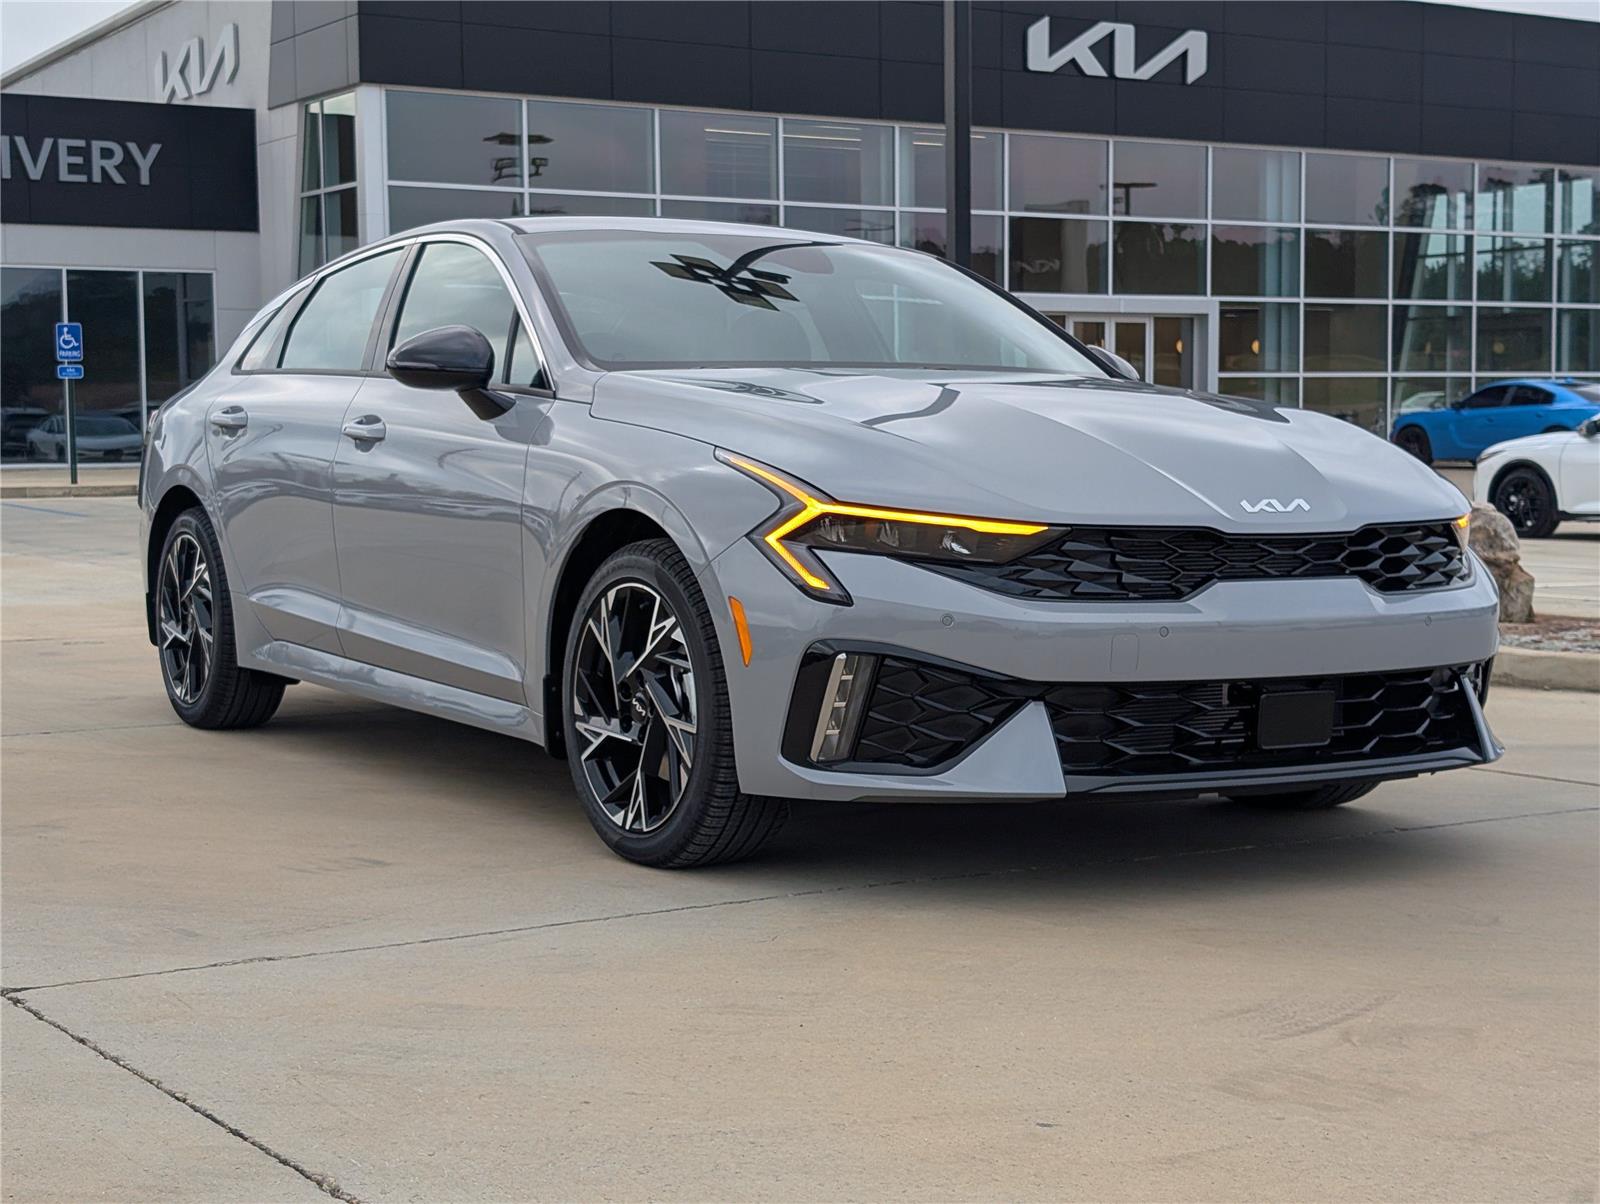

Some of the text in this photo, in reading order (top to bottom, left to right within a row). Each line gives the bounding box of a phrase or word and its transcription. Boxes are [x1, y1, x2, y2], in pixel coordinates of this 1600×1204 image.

[154, 23, 239, 104] KIA
[1026, 15, 1208, 86] KIA
[0, 134, 163, 187] IVERY
[1239, 498, 1311, 513] KIA
